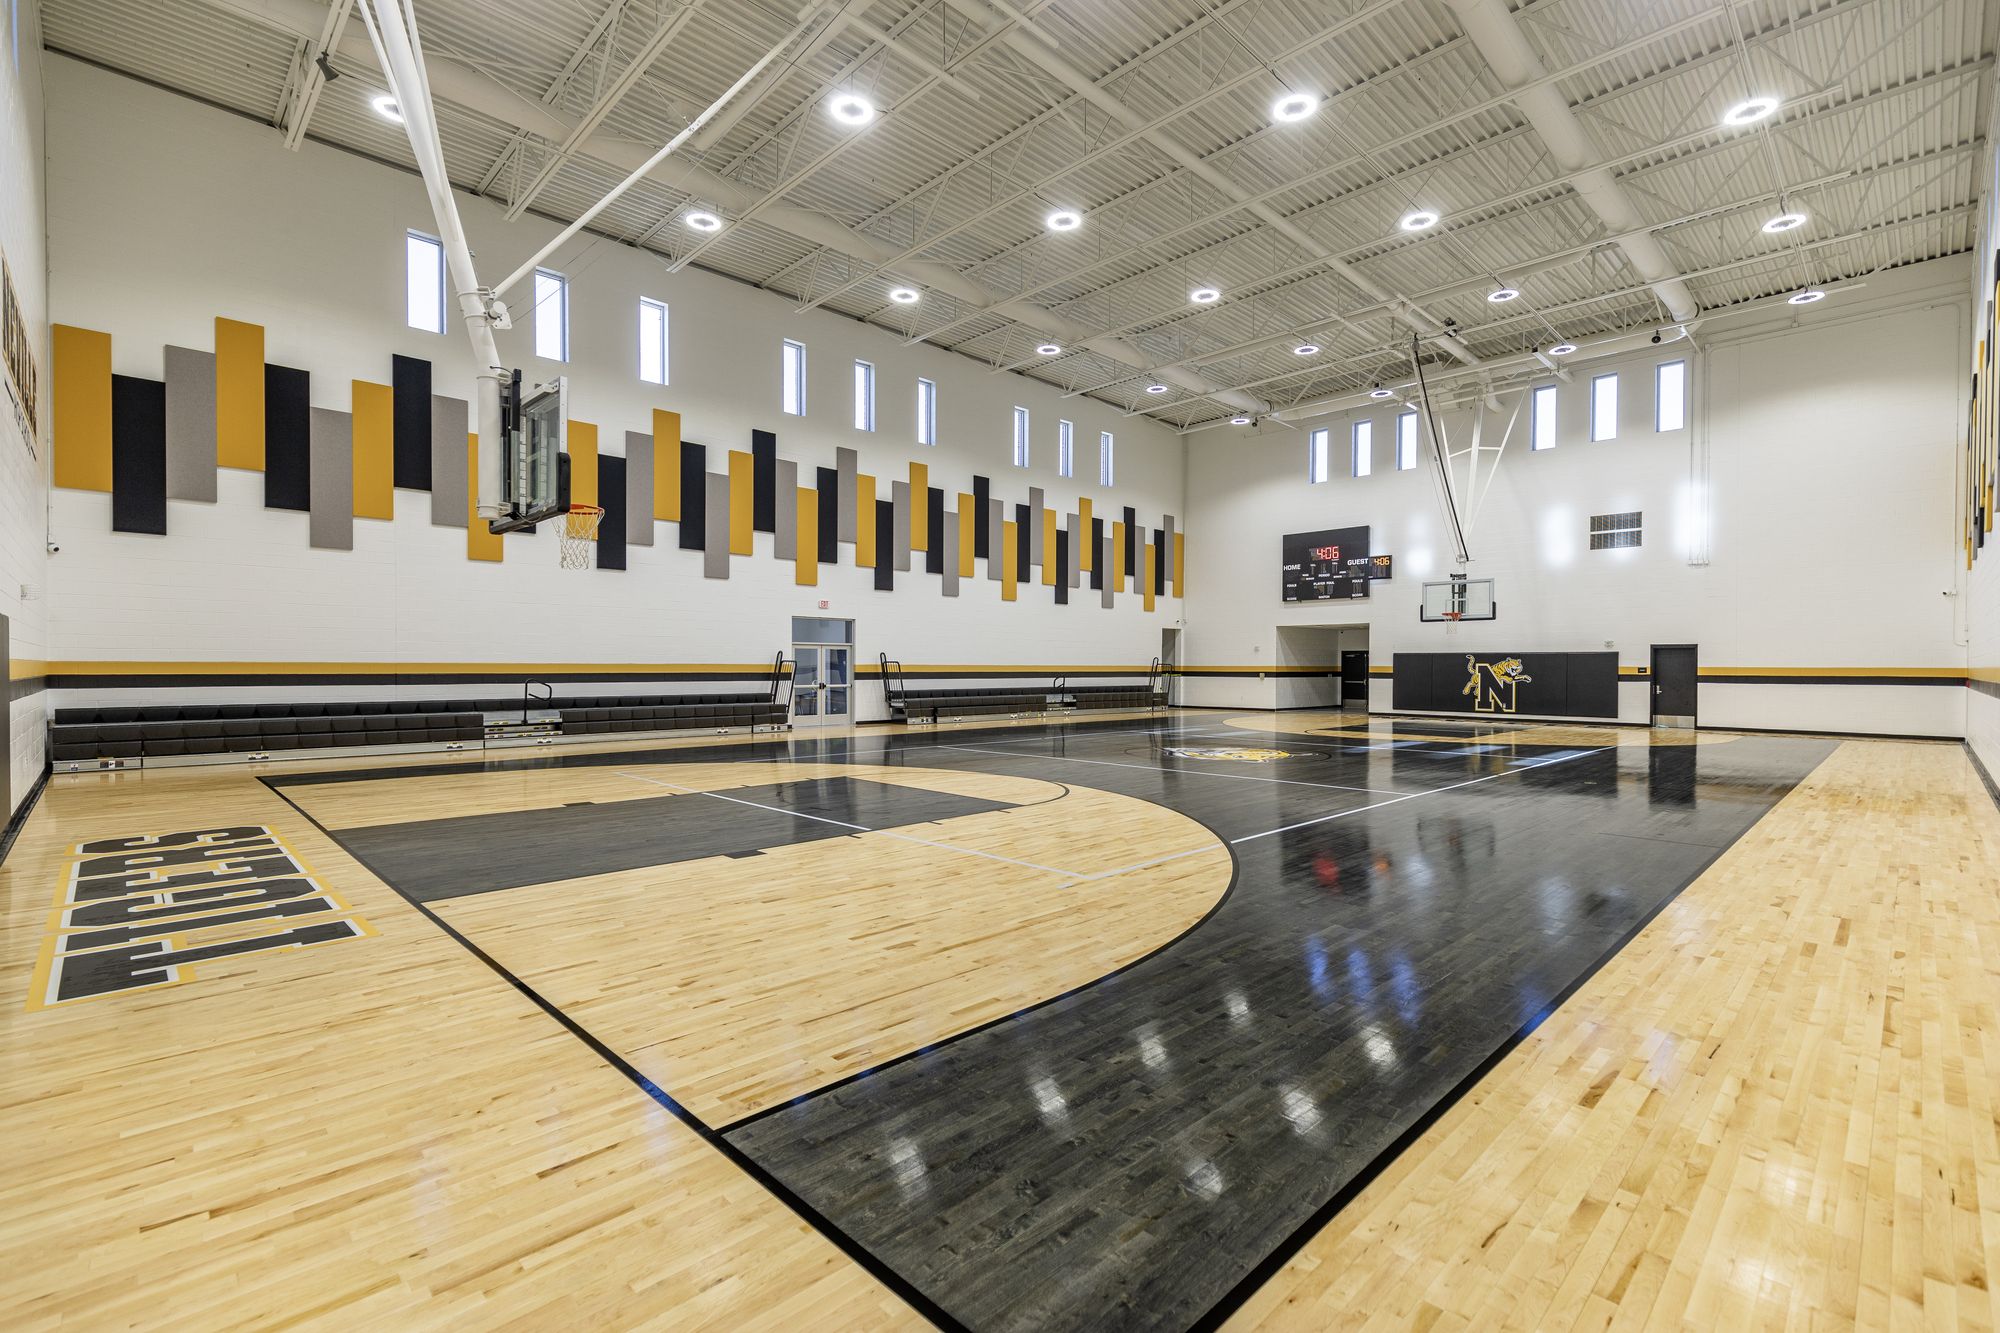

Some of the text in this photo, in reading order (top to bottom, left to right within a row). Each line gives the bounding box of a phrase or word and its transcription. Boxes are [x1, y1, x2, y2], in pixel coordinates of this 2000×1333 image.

[1317, 546, 1339, 560] 4:06
[1347, 558, 1368, 566] GUEST
[1374, 557, 1390, 566] 4:06
[1475, 663, 1515, 712] N
[38, 825, 370, 1008] TIGERS
